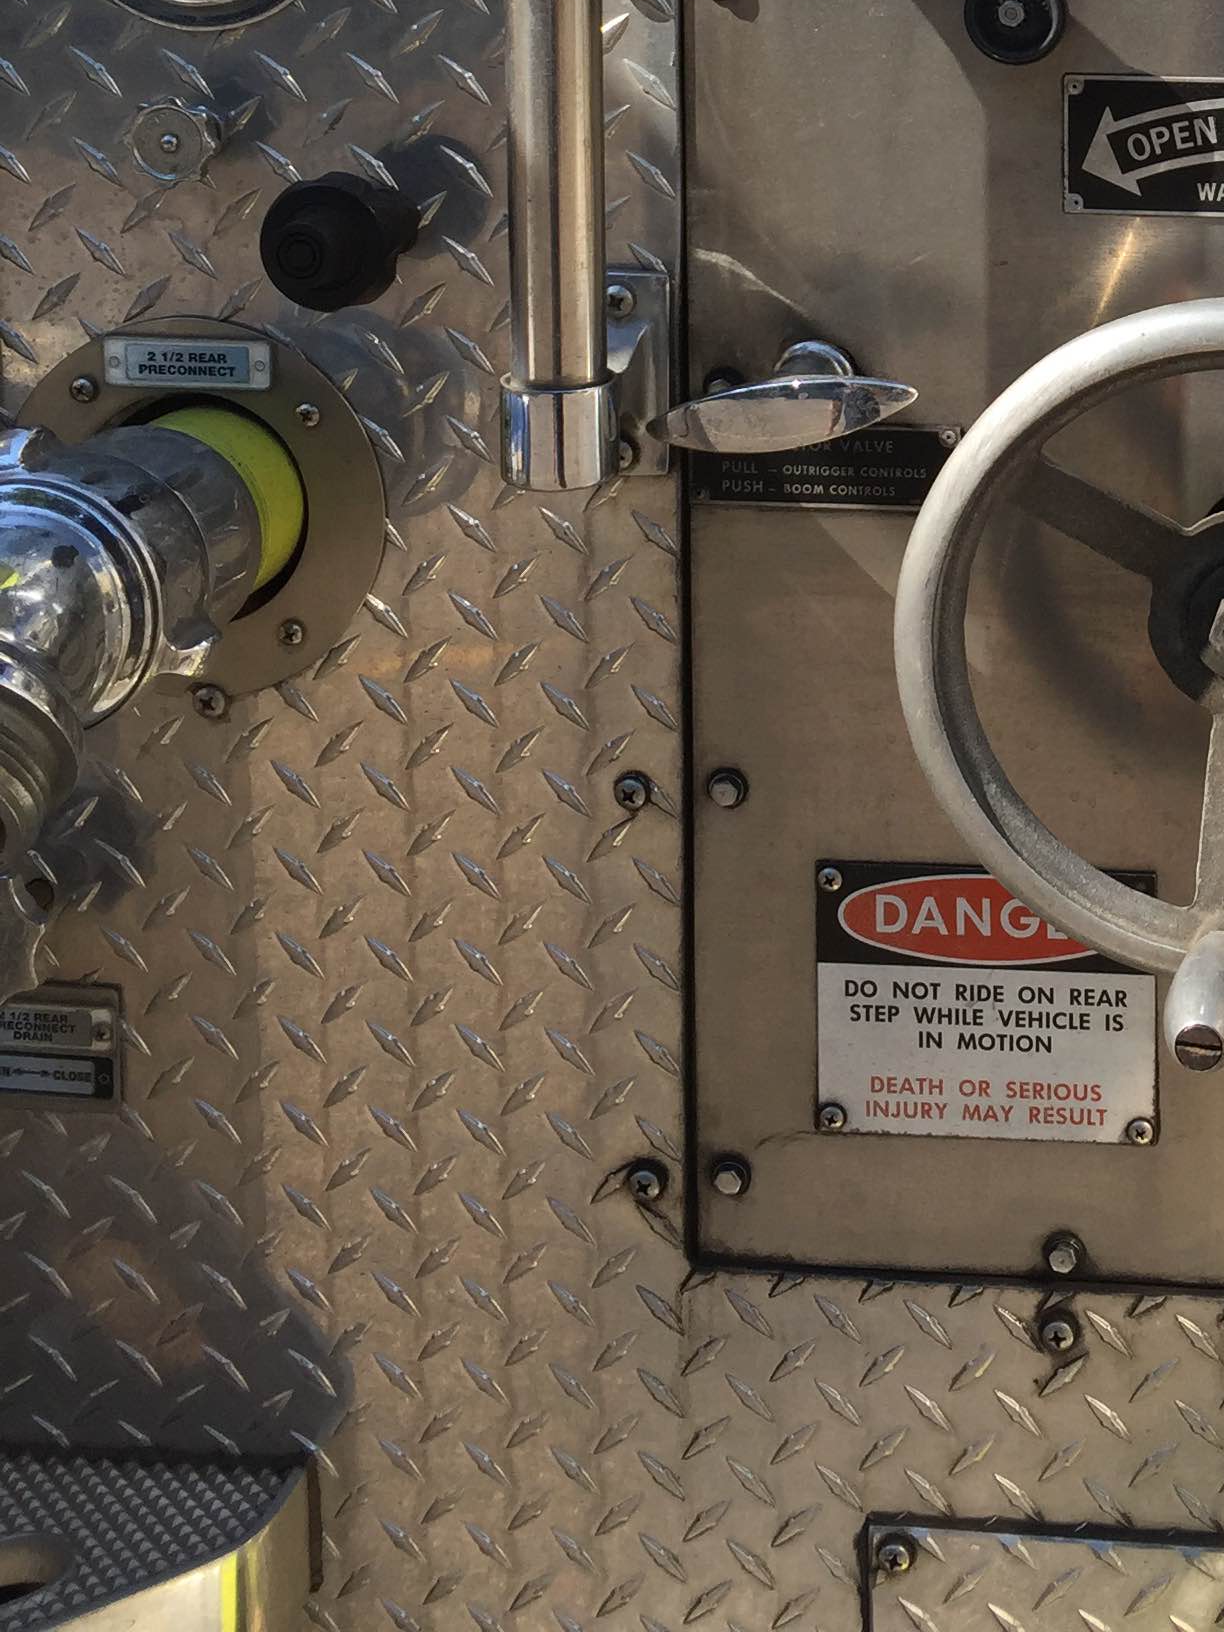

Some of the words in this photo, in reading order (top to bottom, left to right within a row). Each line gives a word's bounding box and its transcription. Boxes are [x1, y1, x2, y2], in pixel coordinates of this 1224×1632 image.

[1126, 115, 1218, 163] OPEN
[147, 351, 157, 362] 2
[161, 351, 184, 363] 1/2
[188, 352, 228, 364] REAR
[138, 363, 236, 377] PRECONNECT
[840, 439, 896, 455] VALVE
[722, 461, 761, 473] PULL
[781, 463, 855, 476] OUTRIGGER
[859, 465, 927, 478] CONTROLS
[722, 480, 764, 492] PUSH
[783, 482, 824, 495] BOOM
[829, 484, 896, 497] CONTROLS
[874, 893, 1070, 941] DANG
[844, 979, 878, 1000] DO
[892, 981, 942, 1002] NOT
[955, 983, 1005, 1005] RIDE
[1017, 985, 1055, 1006] ON
[1069, 987, 1128, 1009] REAR
[849, 1004, 900, 1024] STEP
[913, 1006, 984, 1026] WHILE
[995, 1009, 1091, 1030] VEHICLE
[1105, 1012, 1124, 1031] IS
[13, 1030, 53, 1042] DRAIN
[918, 1031, 943, 1050] IN
[956, 1032, 1052, 1053] MOTION
[870, 1076, 944, 1097] DEATH
[958, 1079, 991, 1098] OR
[1005, 1081, 1102, 1102] SERIOUS
[865, 1100, 948, 1121] INJURY
[961, 1103, 1014, 1123] MAY
[1028, 1105, 1108, 1126] RESULT
